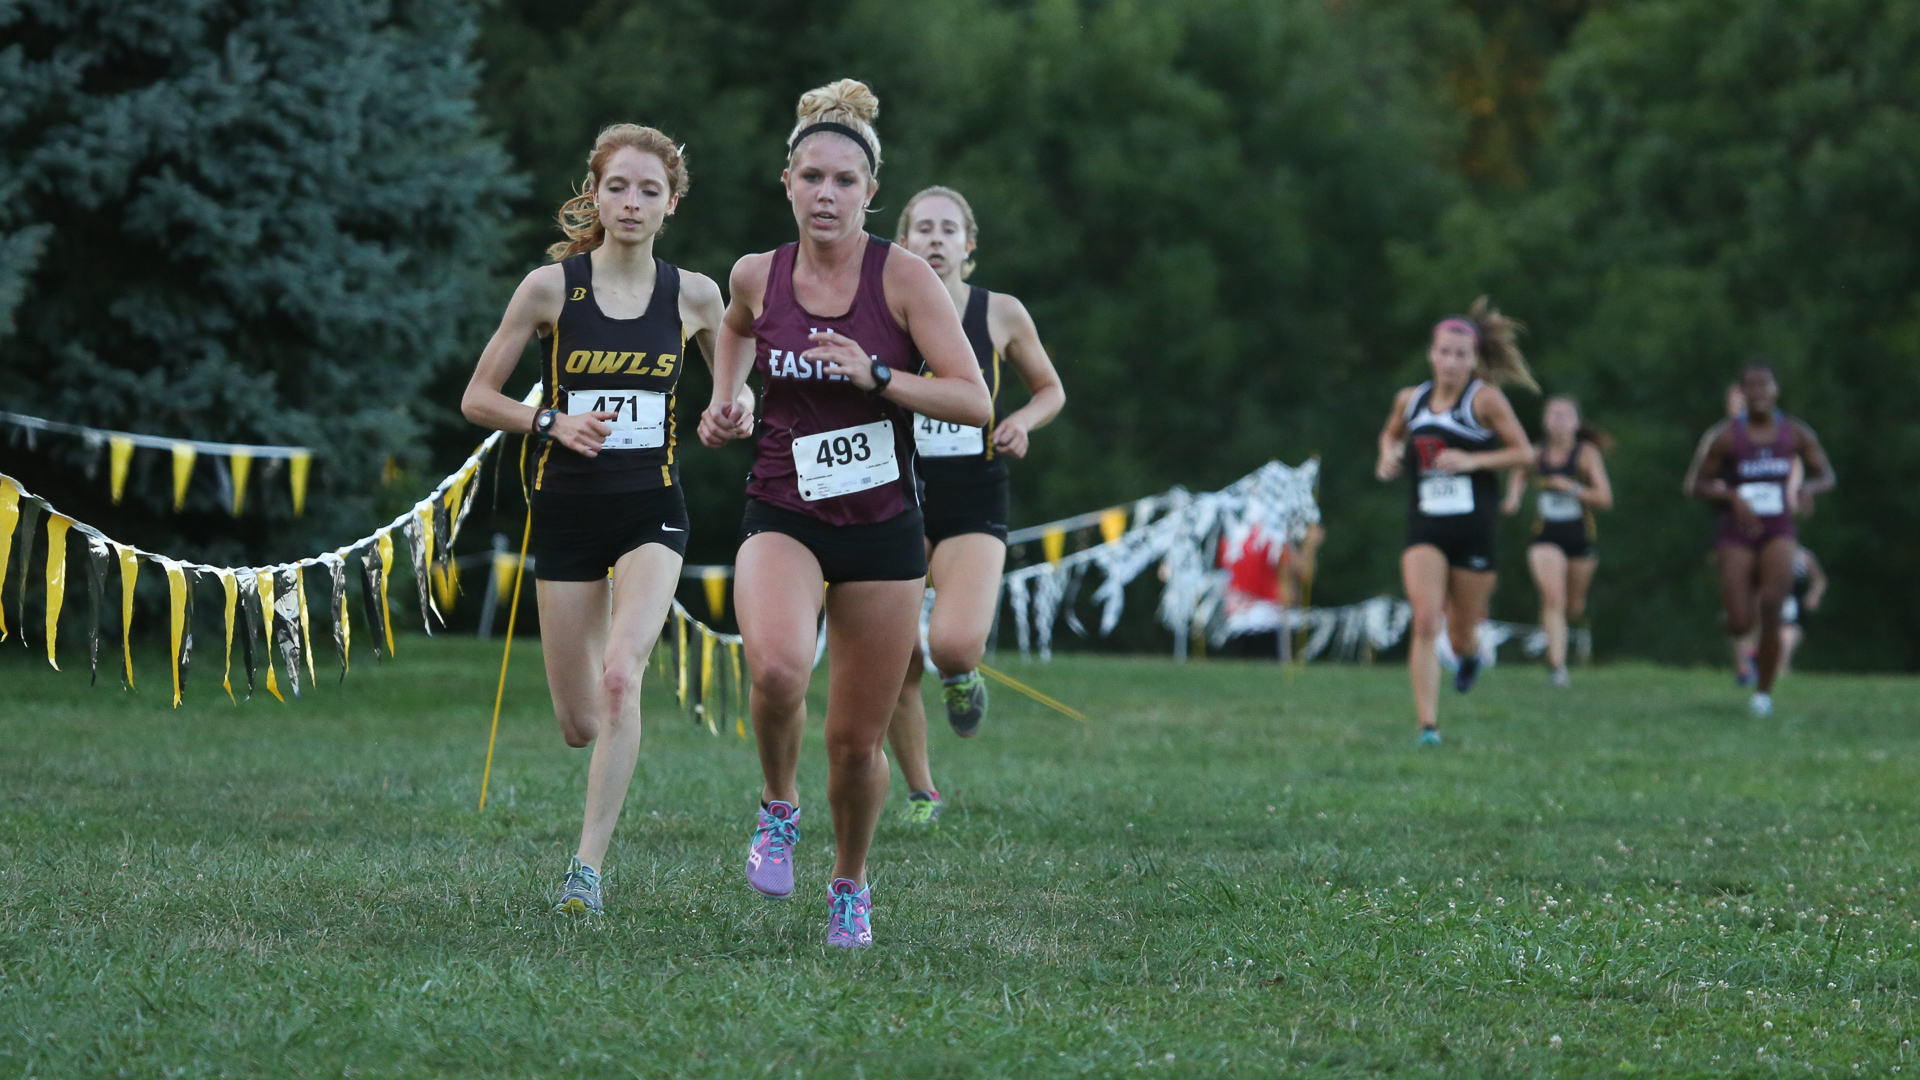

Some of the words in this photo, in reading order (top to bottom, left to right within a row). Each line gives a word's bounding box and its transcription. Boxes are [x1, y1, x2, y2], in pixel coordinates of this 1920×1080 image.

[565, 350, 677, 377] OWLS
[769, 348, 878, 381] EAST
[592, 395, 638, 423] 471
[816, 432, 872, 468] 493
